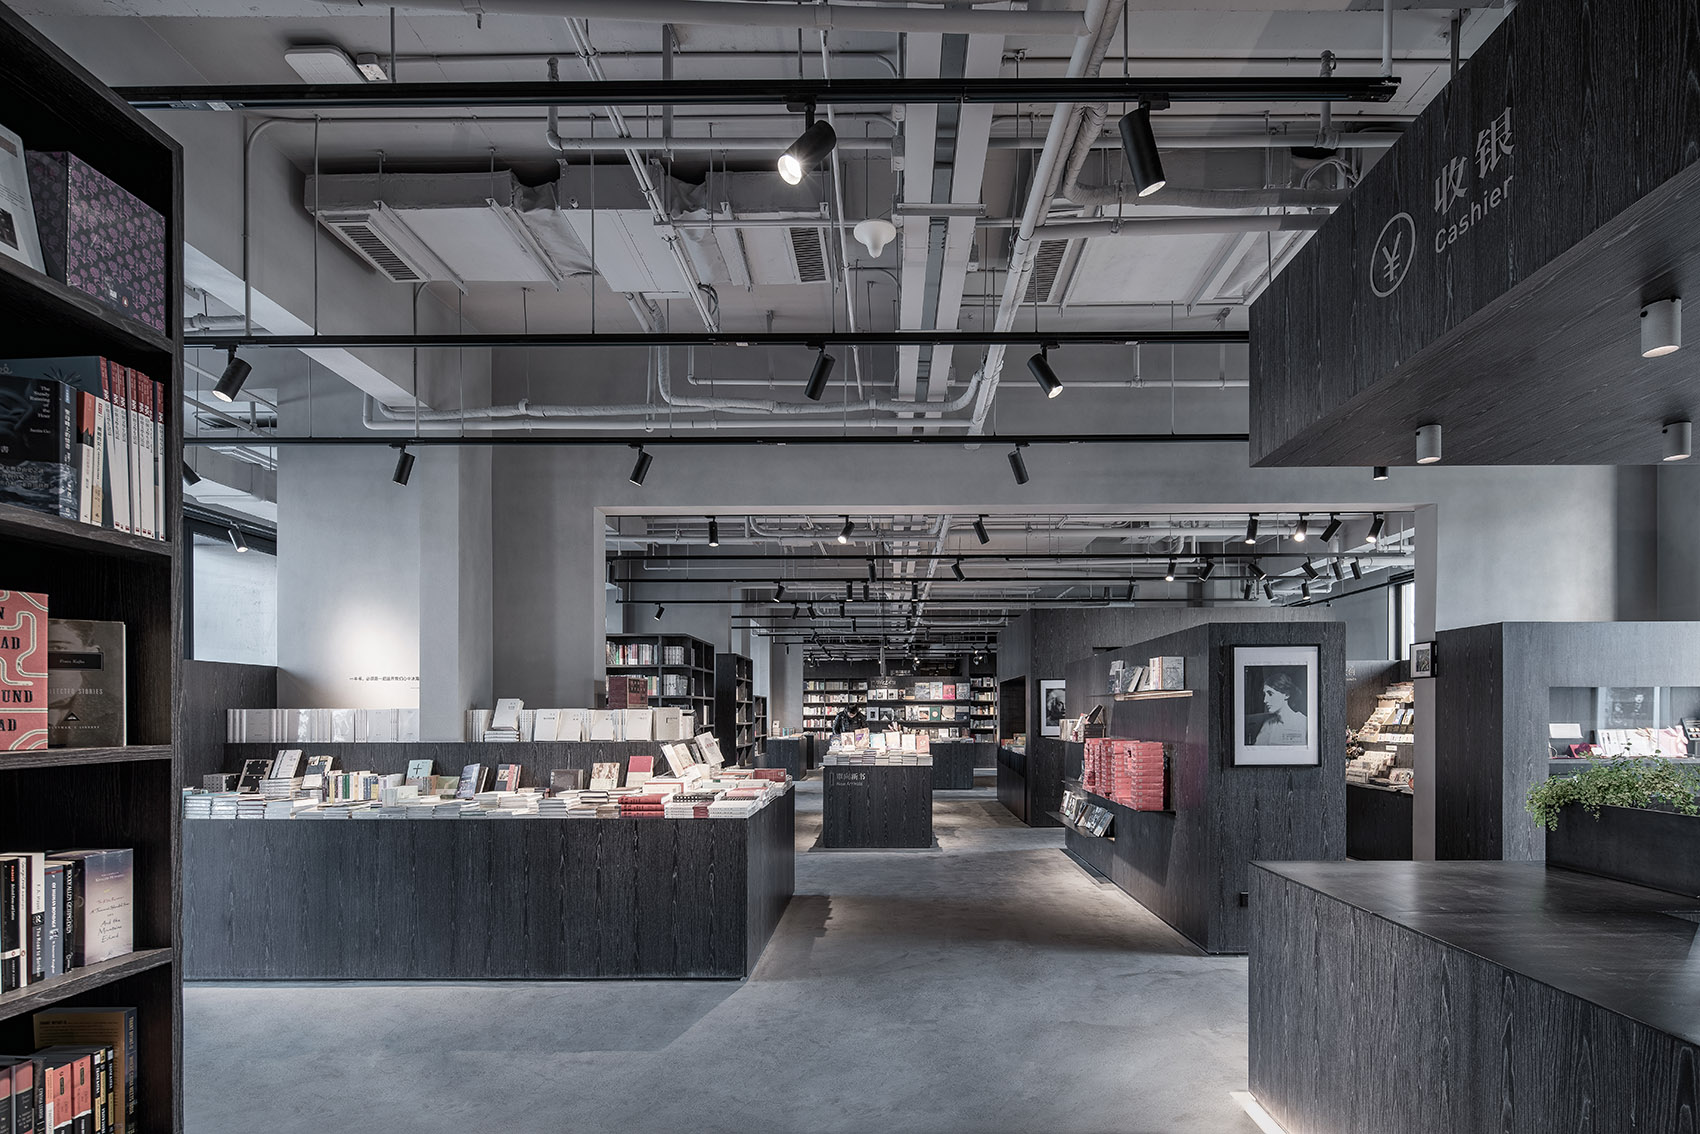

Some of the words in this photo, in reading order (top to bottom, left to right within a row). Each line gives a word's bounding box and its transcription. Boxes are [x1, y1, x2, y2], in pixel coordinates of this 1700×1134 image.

[1434, 106, 1515, 216] 收银
[1435, 174, 1514, 254] Cashier
[2, 690, 33, 703] UND
